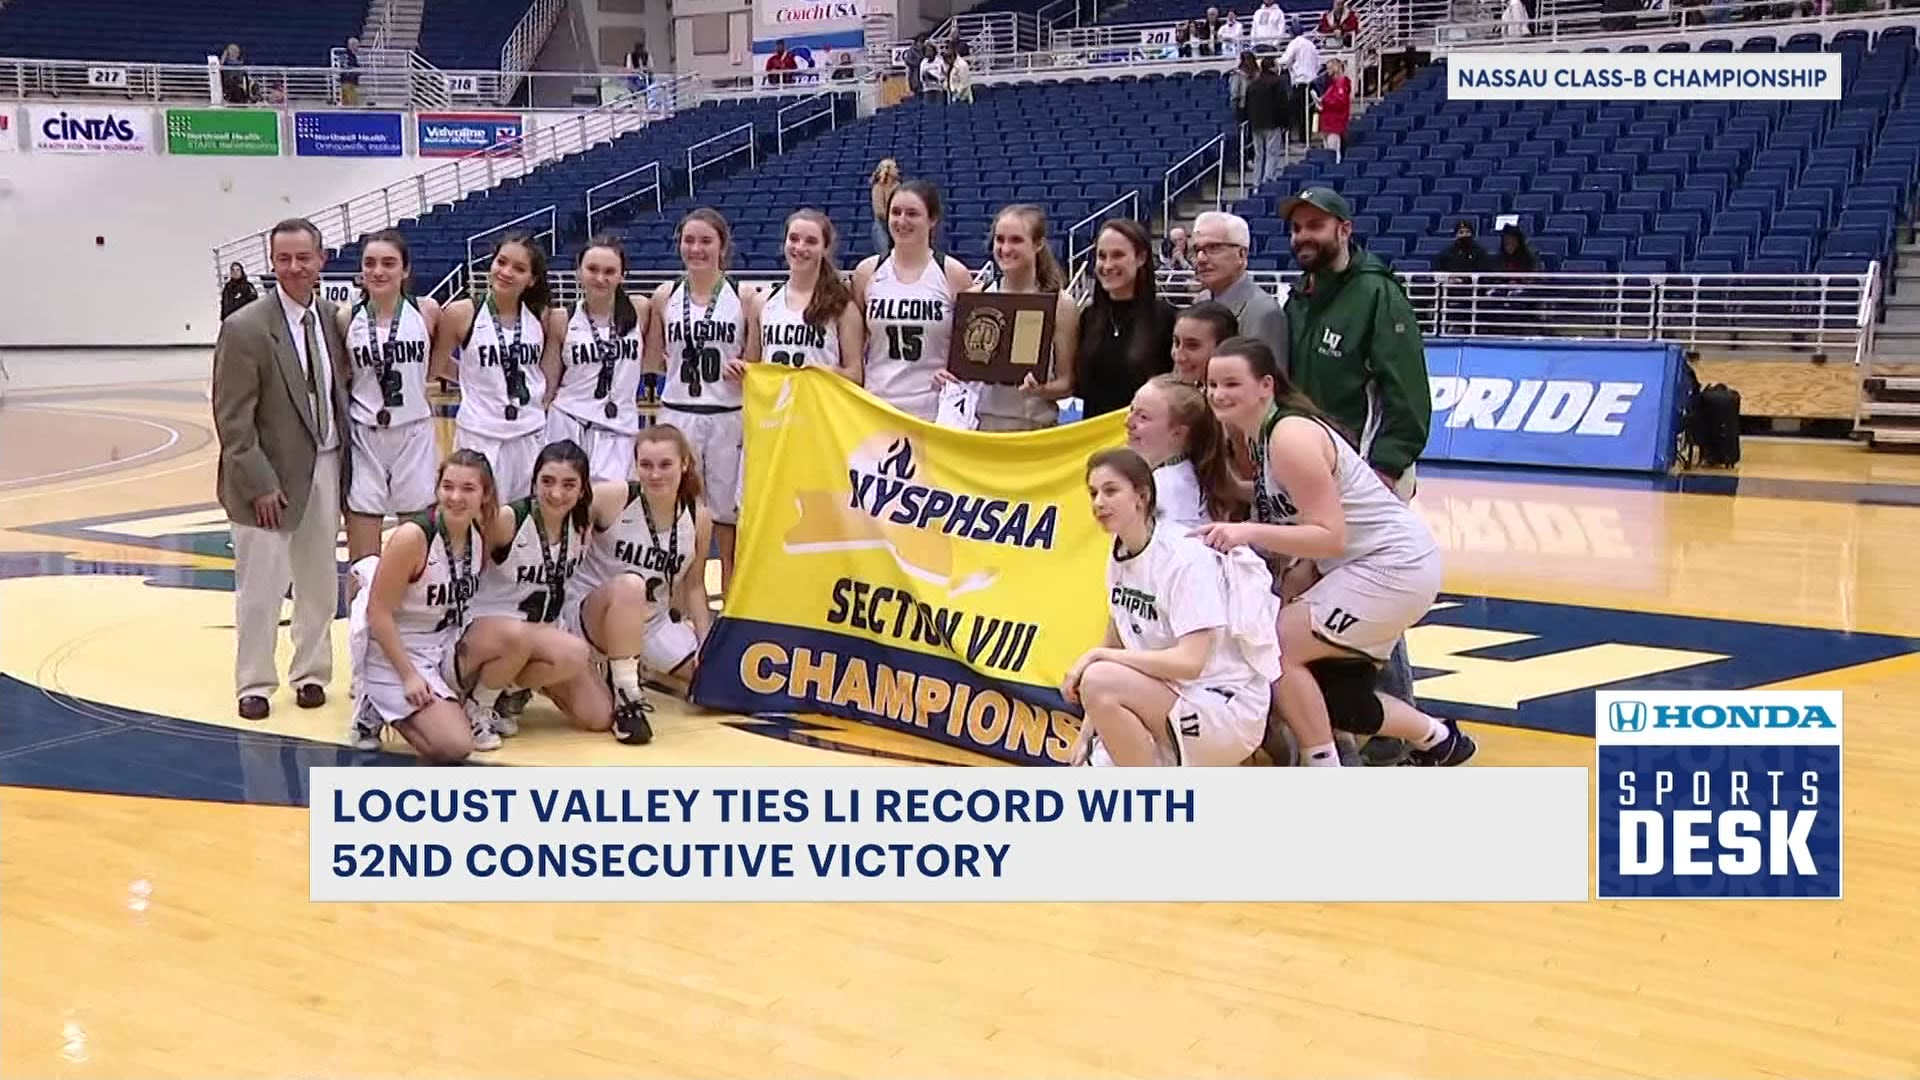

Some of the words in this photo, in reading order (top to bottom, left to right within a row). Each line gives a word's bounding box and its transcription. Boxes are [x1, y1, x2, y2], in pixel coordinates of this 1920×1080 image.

[1146, 32, 1171, 44] 201
[95, 71, 120, 82] 217
[425, 126, 486, 138] Valvoline
[325, 286, 349, 301] 100
[869, 299, 943, 321] FALCONS
[885, 325, 924, 361] 15
[1428, 376, 1644, 437] PRIDE
[1324, 607, 1361, 634] LV
[965, 615, 1038, 672] VIII
[739, 641, 1084, 764] CHAMPIONS
[1180, 712, 1200, 737] LV
